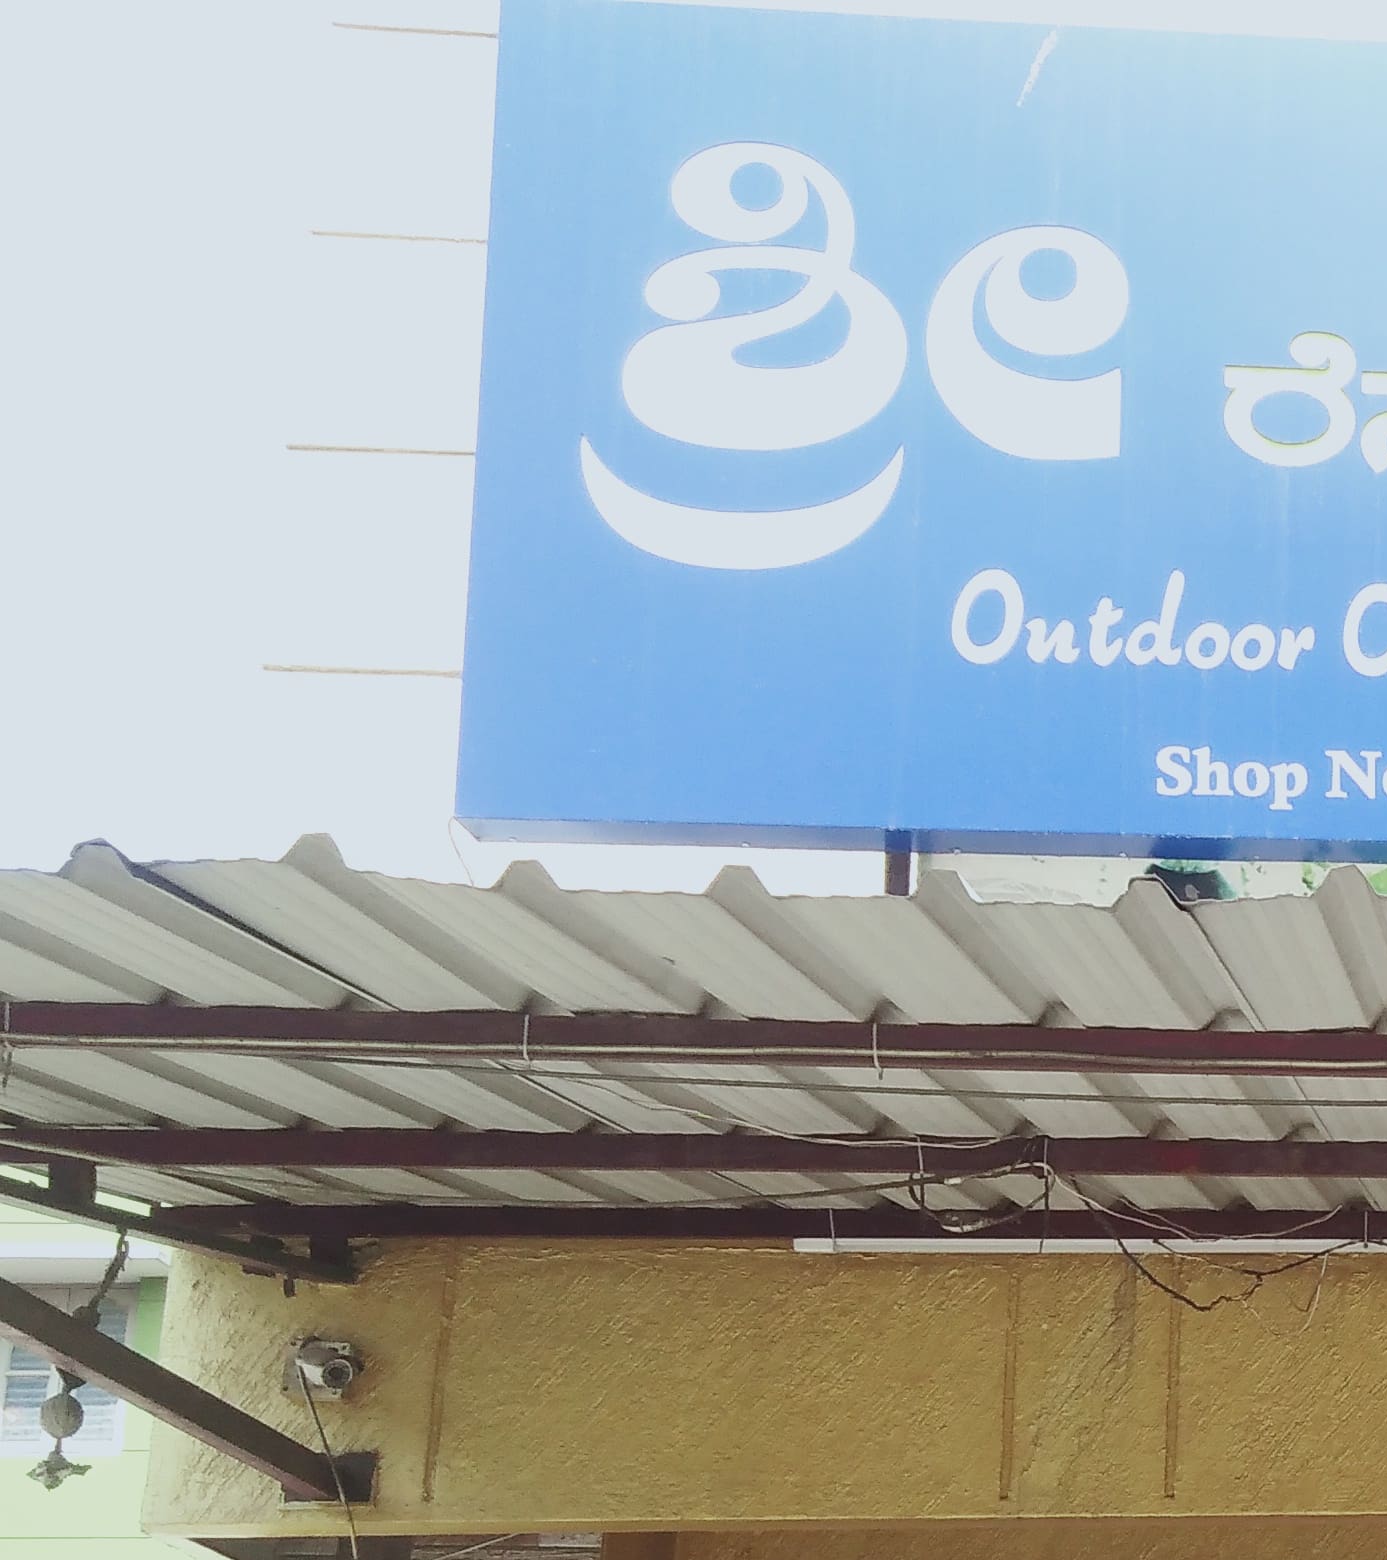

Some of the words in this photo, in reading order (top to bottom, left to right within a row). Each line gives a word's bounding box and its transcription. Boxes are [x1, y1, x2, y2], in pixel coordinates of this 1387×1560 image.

[580, 141, 1131, 570] ಶ್ರೀ
[951, 568, 1315, 671] Outdoor
[1156, 746, 1308, 811] Shop
